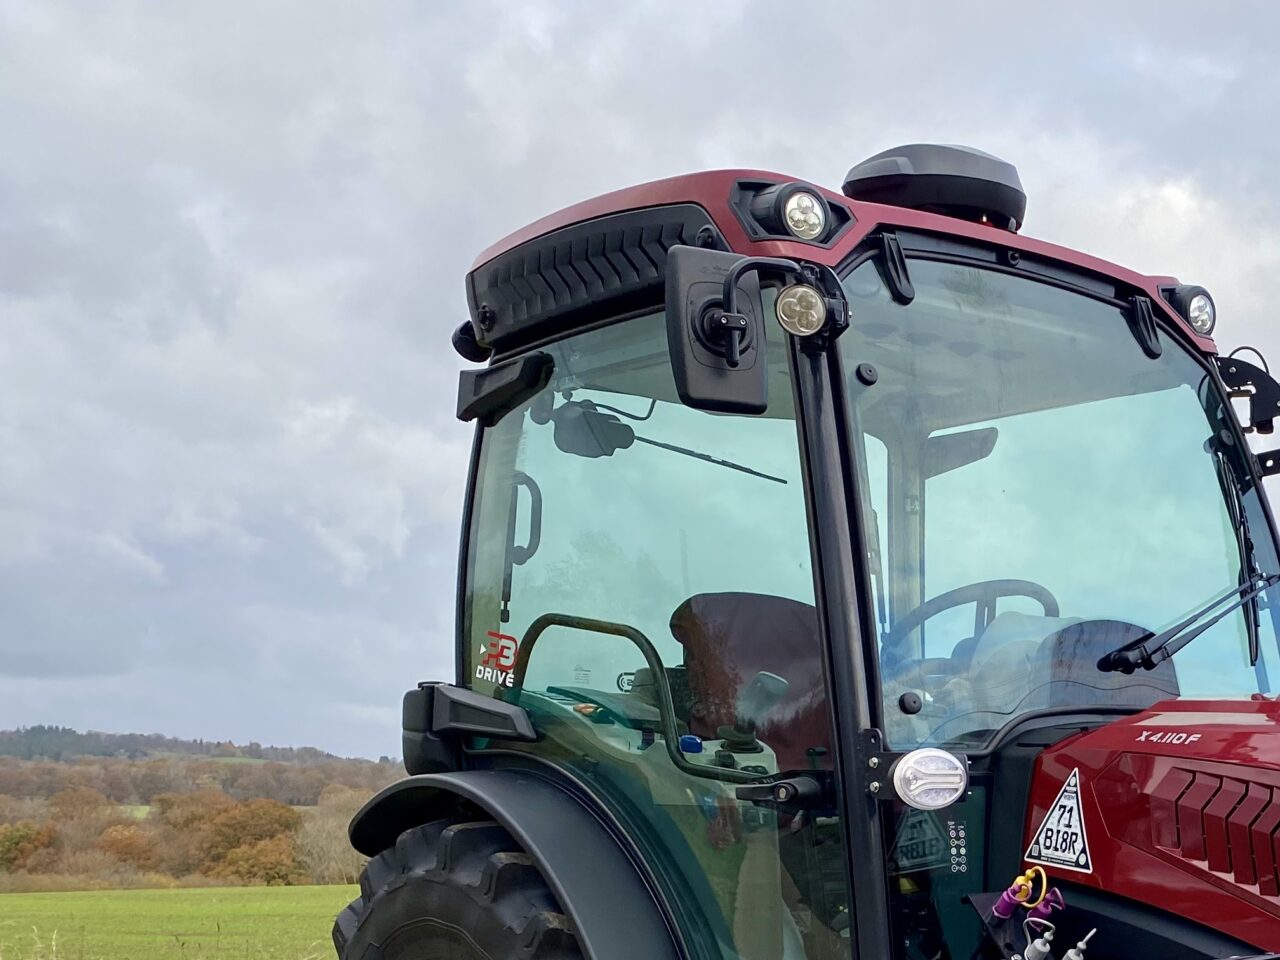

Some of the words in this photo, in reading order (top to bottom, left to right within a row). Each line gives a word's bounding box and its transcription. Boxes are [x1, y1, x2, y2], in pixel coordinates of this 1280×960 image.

[475, 664, 515, 688] DRIVE
[1057, 804, 1074, 828] 71
[1043, 827, 1079, 855] BI8R
